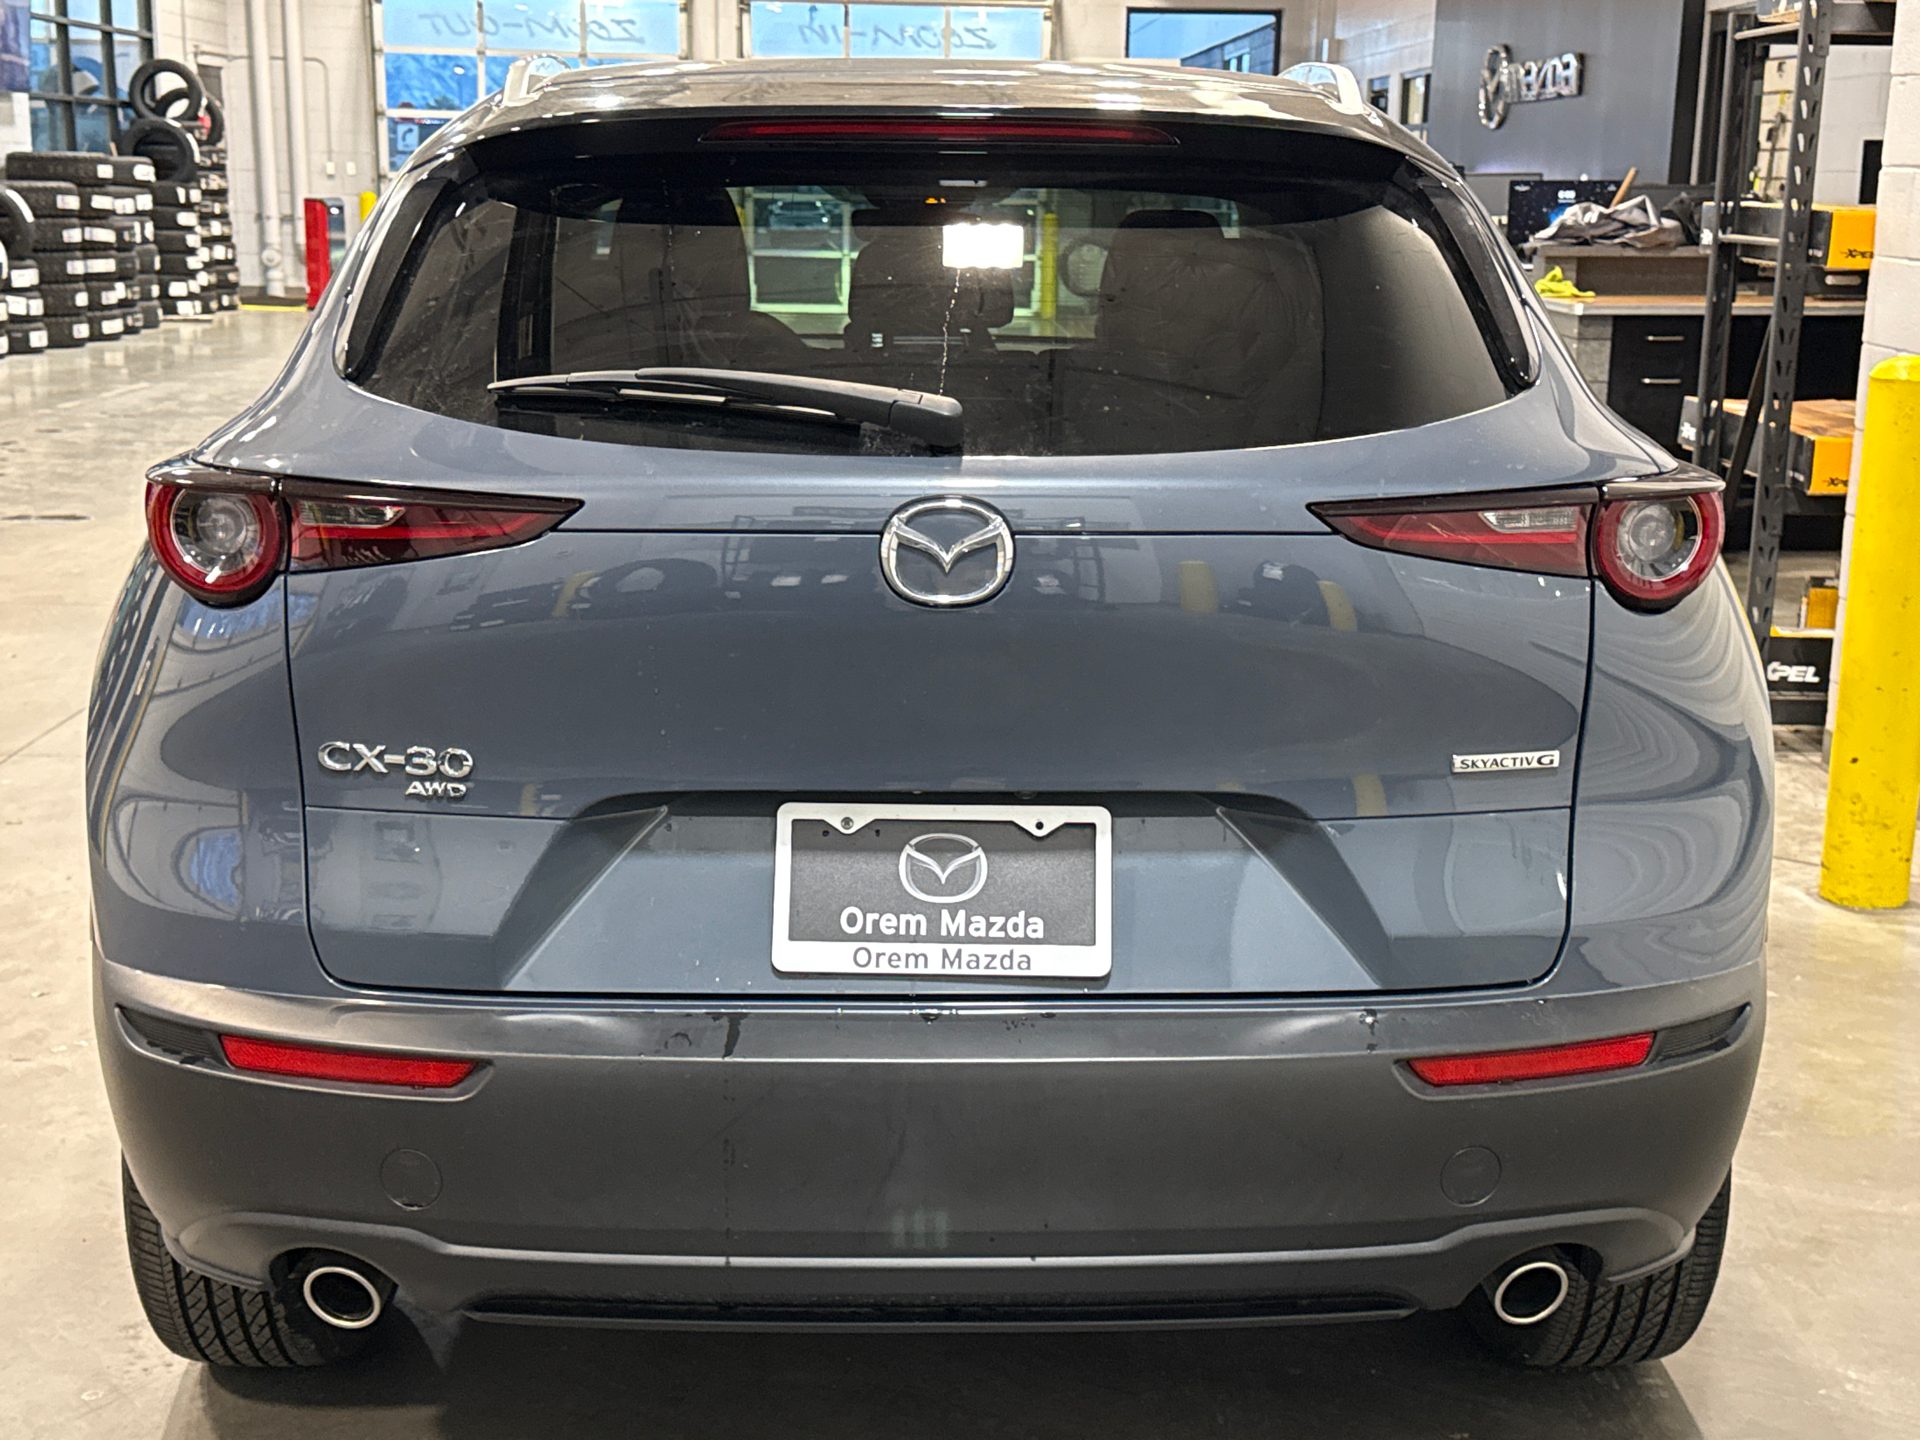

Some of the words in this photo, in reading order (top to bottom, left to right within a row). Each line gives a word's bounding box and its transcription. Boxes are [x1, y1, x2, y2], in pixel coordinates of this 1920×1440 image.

[317, 741, 474, 779] CX-30
[404, 780, 468, 798] AWD
[839, 905, 927, 936] Orem
[940, 908, 1045, 939] Mazda
[852, 946, 929, 969] Orem
[941, 948, 1032, 971] Mazda
